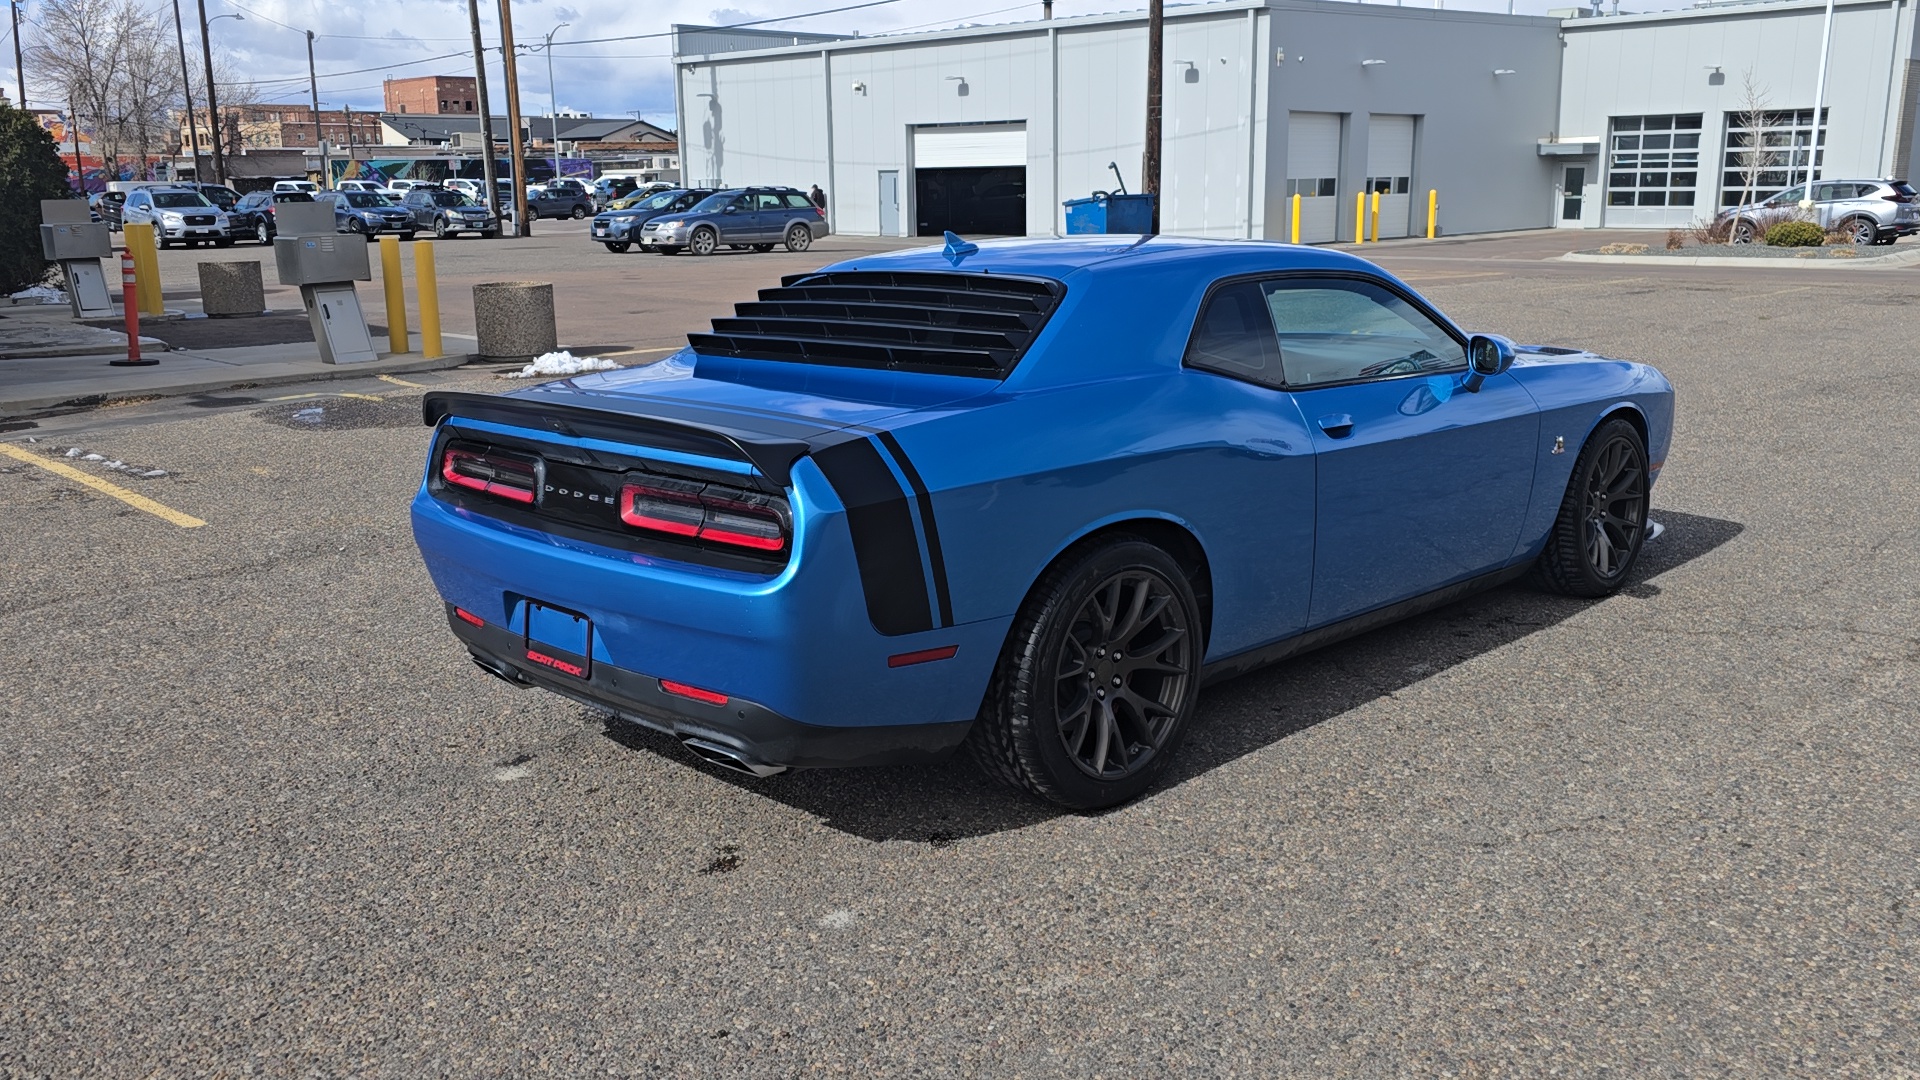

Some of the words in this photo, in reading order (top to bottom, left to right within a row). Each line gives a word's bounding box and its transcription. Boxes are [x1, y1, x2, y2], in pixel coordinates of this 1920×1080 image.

[545, 485, 615, 504] DODGE
[527, 650, 554, 666] SCAT
[553, 659, 582, 676] PACK
